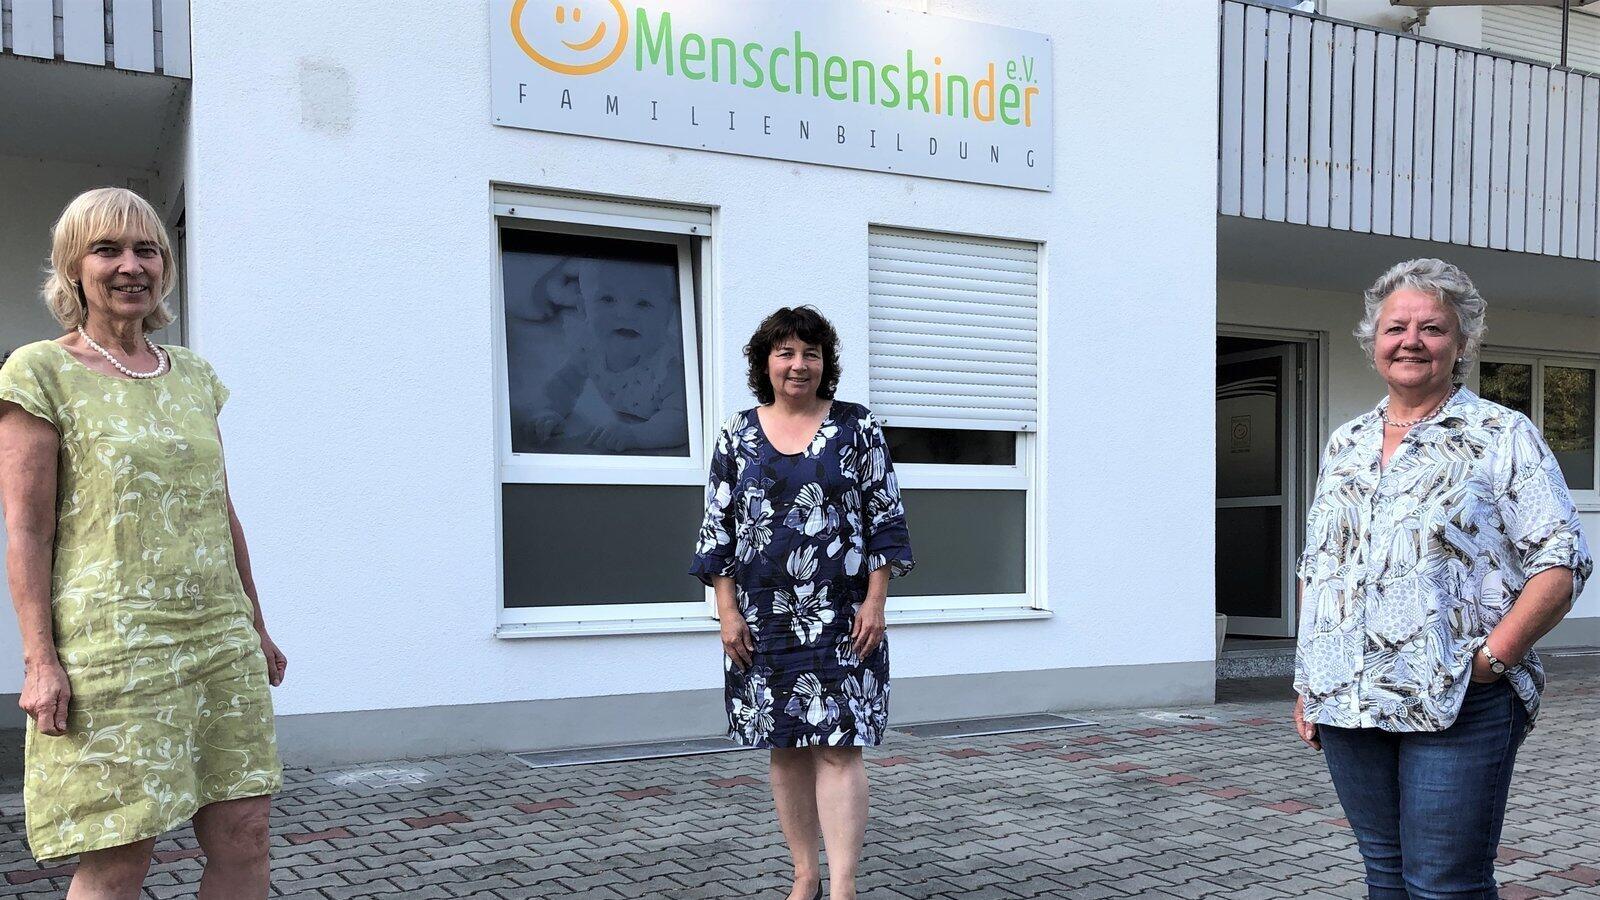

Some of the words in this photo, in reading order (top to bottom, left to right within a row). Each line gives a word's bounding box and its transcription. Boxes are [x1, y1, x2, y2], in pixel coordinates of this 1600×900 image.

[636, 7, 1039, 127] Menschenskinder
[1007, 55, 1037, 83] e.V.
[519, 83, 1034, 167] FAMILIENBILDUNG
